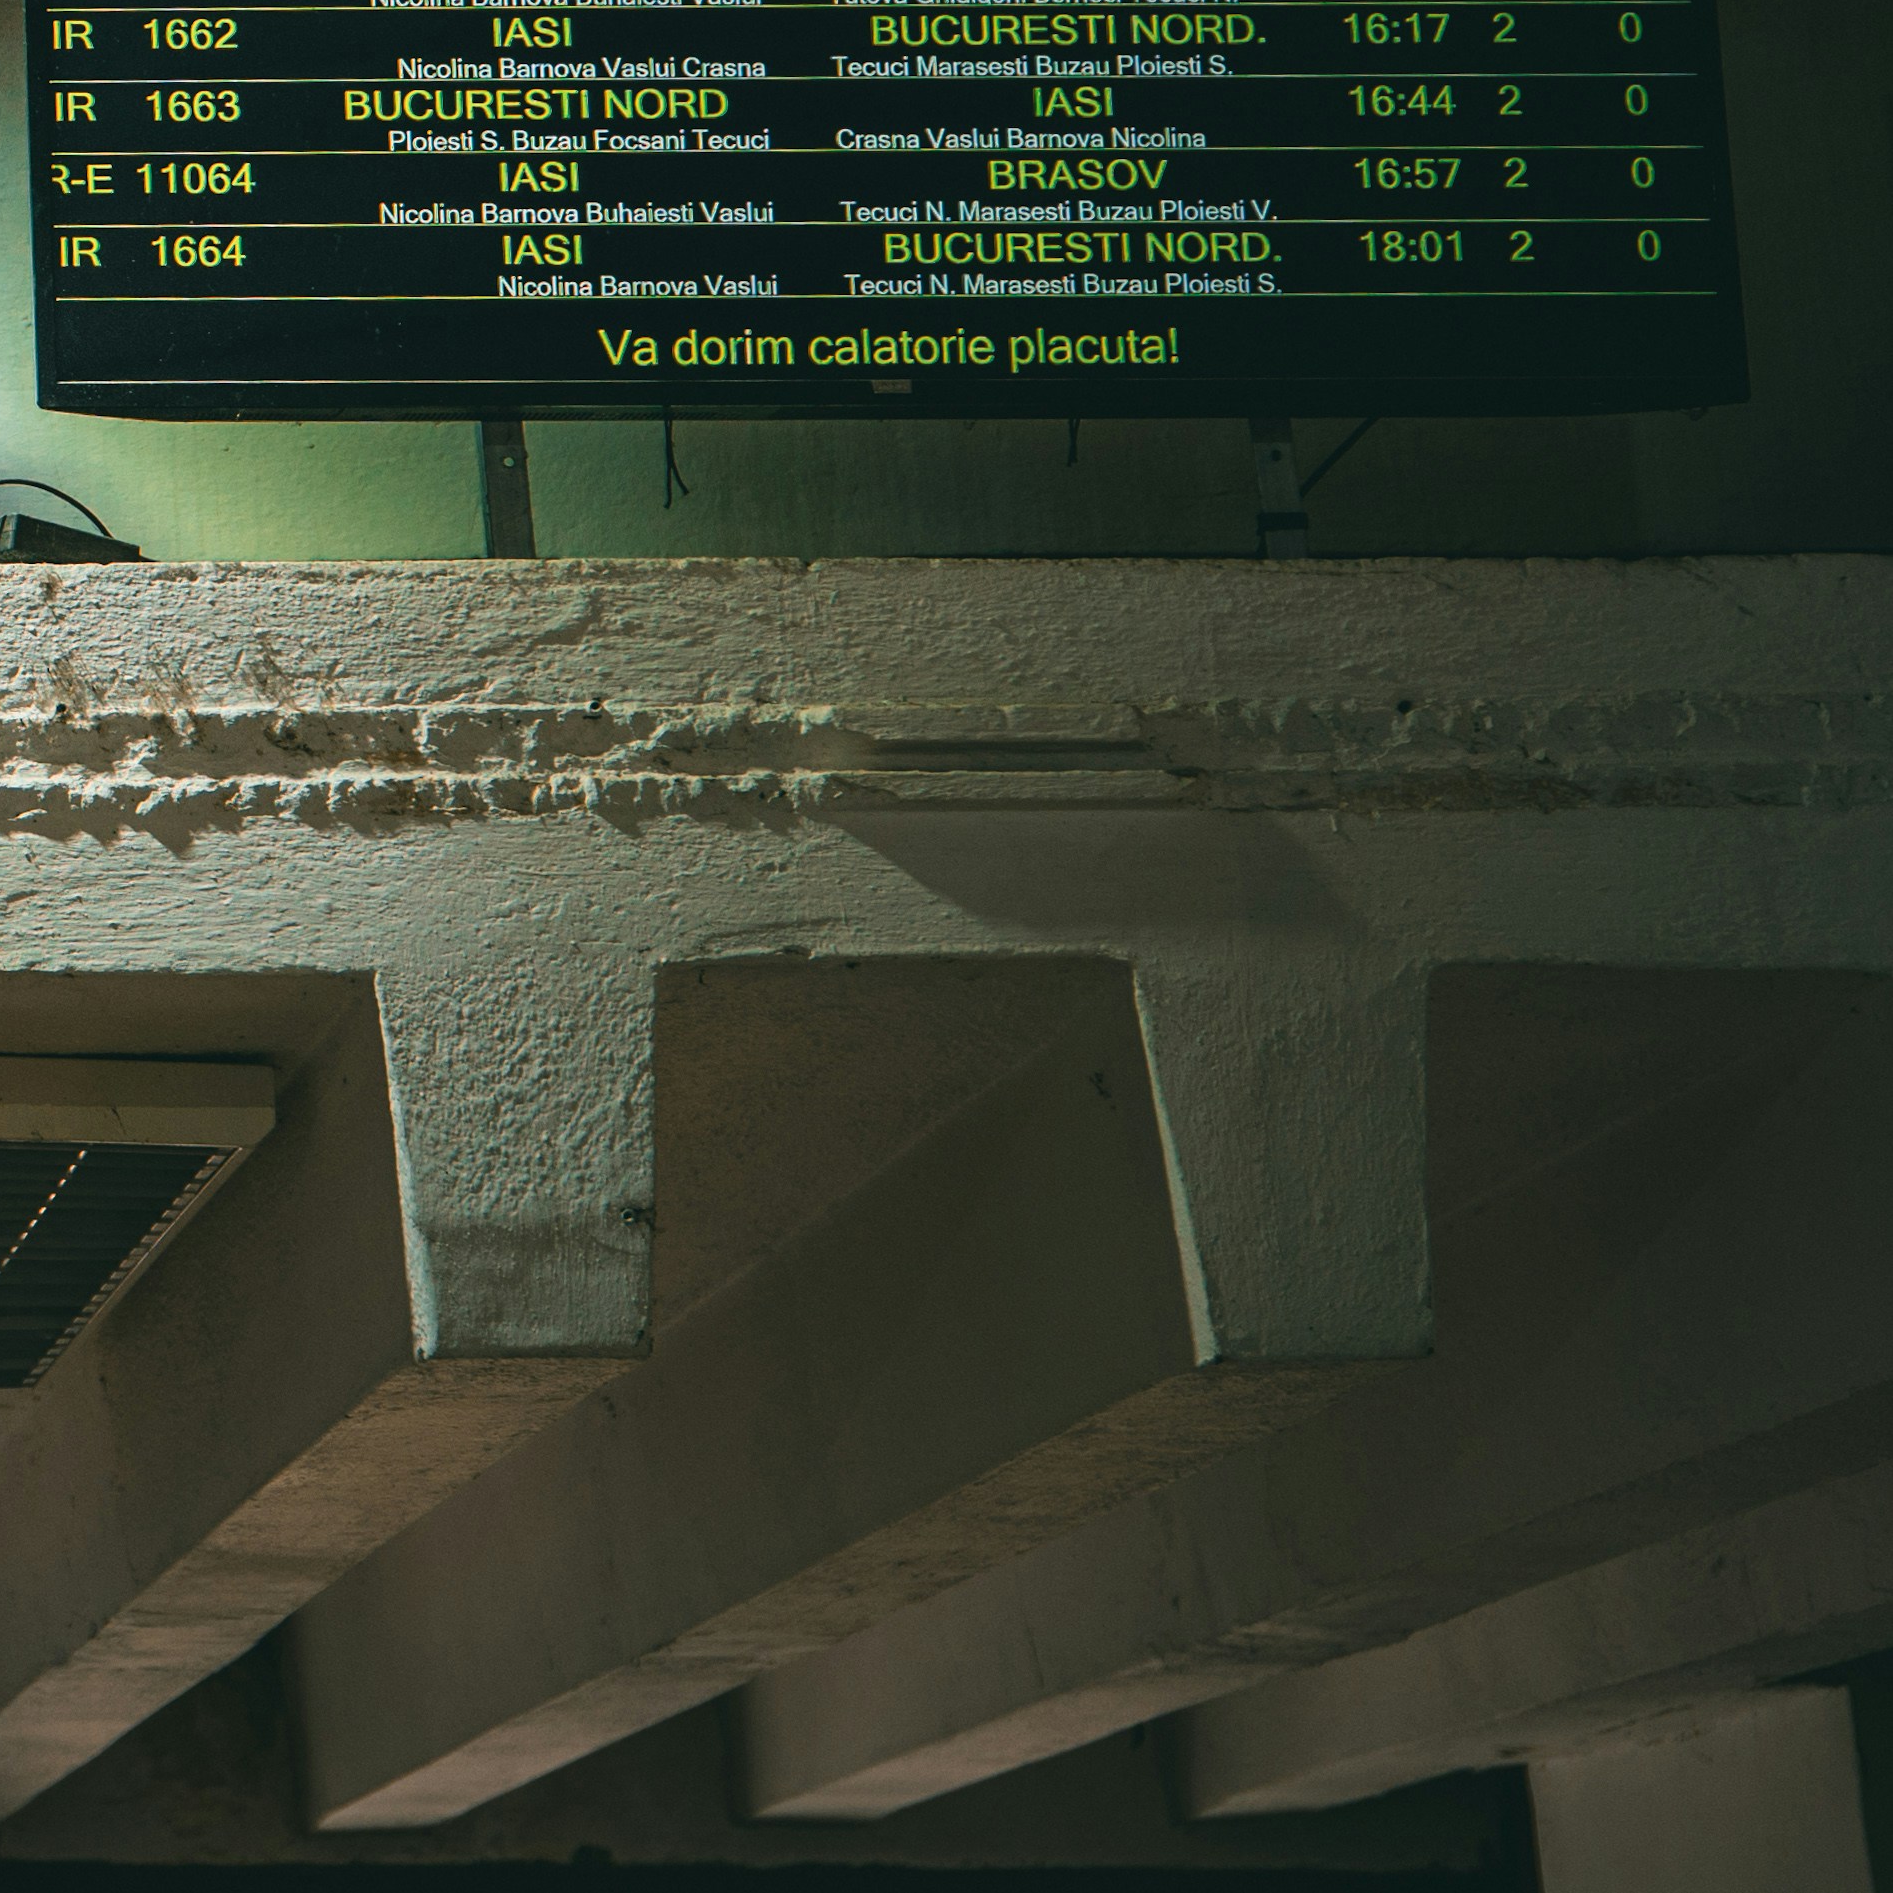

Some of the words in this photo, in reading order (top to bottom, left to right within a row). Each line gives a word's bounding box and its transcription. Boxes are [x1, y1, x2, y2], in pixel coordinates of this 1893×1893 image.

[55, 92, 97, 122] IR
[146, 90, 242, 122] 1663
[344, 88, 590, 121] BUCURESTI
[604, 88, 729, 120] NORD
[1034, 86, 1114, 118] IASI
[1349, 84, 1457, 117] 16:44
[1498, 84, 1523, 115] 2
[1625, 84, 1649, 116] 0
[389, 129, 473, 152] Ploiesti
[481, 129, 505, 152] S.
[512, 129, 587, 152] Buzau
[594, 128, 685, 152] Focsani
[691, 128, 769, 152] Tecuci
[836, 128, 920, 150] Crasna
[925, 127, 999, 150] Vaslui
[1007, 127, 1104, 150] Barnova
[1111, 126, 1206, 150] Nicolina
[60, 236, 102, 268] IR
[151, 235, 247, 267] 1664
[503, 234, 583, 266] IASI
[884, 231, 1131, 264] BUCURESTI
[1145, 231, 1282, 263] NORD.
[1360, 230, 1463, 262] 18:01
[1510, 230, 1535, 261] 2
[1637, 229, 1662, 261] 0
[498, 275, 593, 297] Nicolina
[600, 275, 698, 297] Barnova
[703, 274, 777, 297] Vaslui
[843, 273, 922, 296] Tecuci
[929, 273, 955, 296] N.
[963, 273, 1076, 296] Marasesti
[1083, 273, 1158, 296] Buzau
[1165, 272, 1250, 296] Ploiesti
[1258, 272, 1282, 296] S.
[598, 329, 659, 367] Va
[673, 328, 795, 366] dorim
[809, 327, 995, 366] calatorie
[1010, 327, 1179, 374] placuta!
